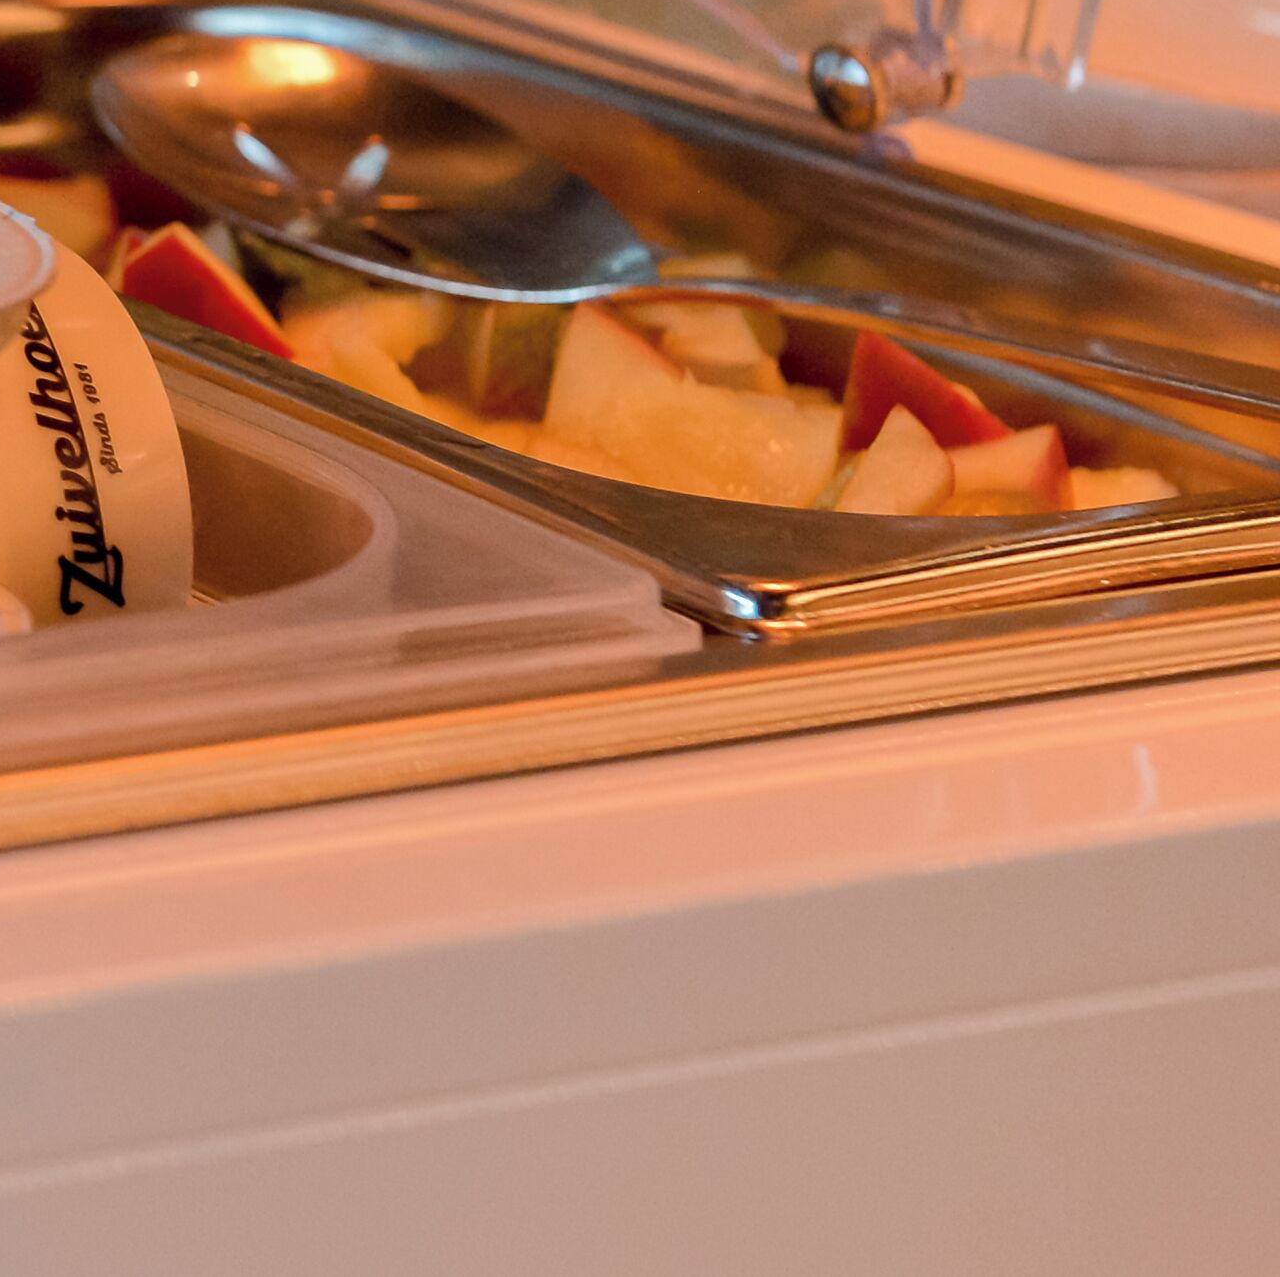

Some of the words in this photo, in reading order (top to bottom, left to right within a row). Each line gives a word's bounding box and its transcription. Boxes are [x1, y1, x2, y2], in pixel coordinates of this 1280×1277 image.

[73, 361, 101, 404] 1981
[23, 299, 126, 616] Zuivelhoe
[93, 411, 124, 475] Sinds
